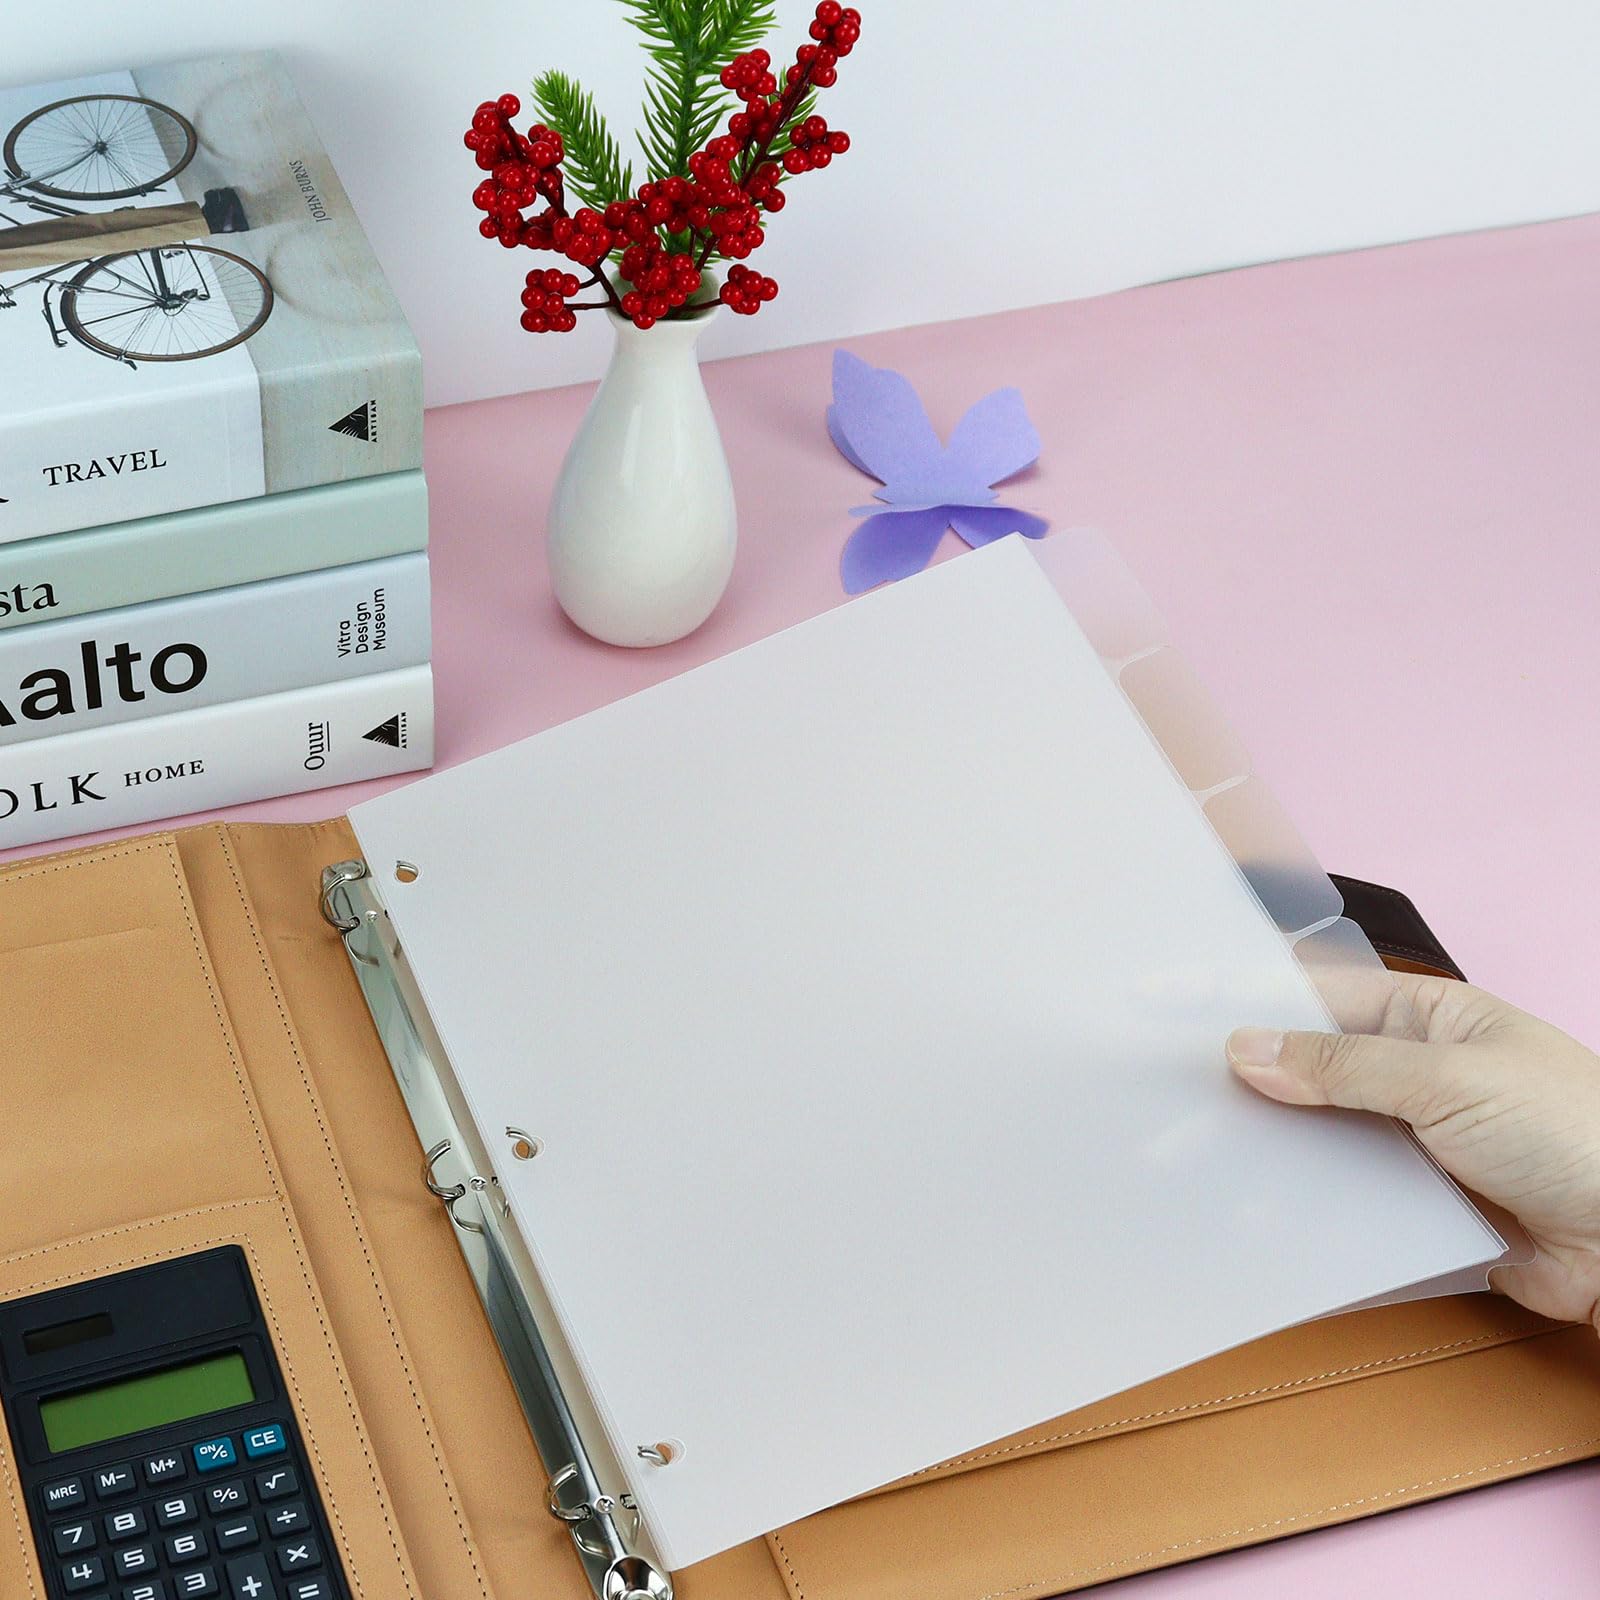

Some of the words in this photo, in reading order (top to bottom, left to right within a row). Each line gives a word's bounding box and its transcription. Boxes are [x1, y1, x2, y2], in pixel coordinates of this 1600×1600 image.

[288, 159, 315, 193] BURNS
[305, 194, 333, 223] JOHN
[370, 399, 378, 443] ARTISAN
[43, 450, 166, 486] TRAVEL
[337, 619, 351, 658] Vitra
[355, 601, 372, 654] Design
[372, 588, 386, 651] Museum
[0, 640, 208, 727] alto
[304, 722, 325, 770] Ouur
[124, 759, 205, 787] HOME
[49, 1484, 78, 1501] MRC
[150, 1457, 176, 1474] M+
[250, 1430, 277, 1448] CE
[62, 1526, 83, 1544] 7
[113, 1512, 136, 1531] 8
[164, 1499, 186, 1518] 9
[212, 1488, 238, 1503] %
[71, 1563, 93, 1579] 4
[123, 1548, 145, 1568] 5
[174, 1535, 196, 1554] 6
[183, 1572, 206, 1592] 3
